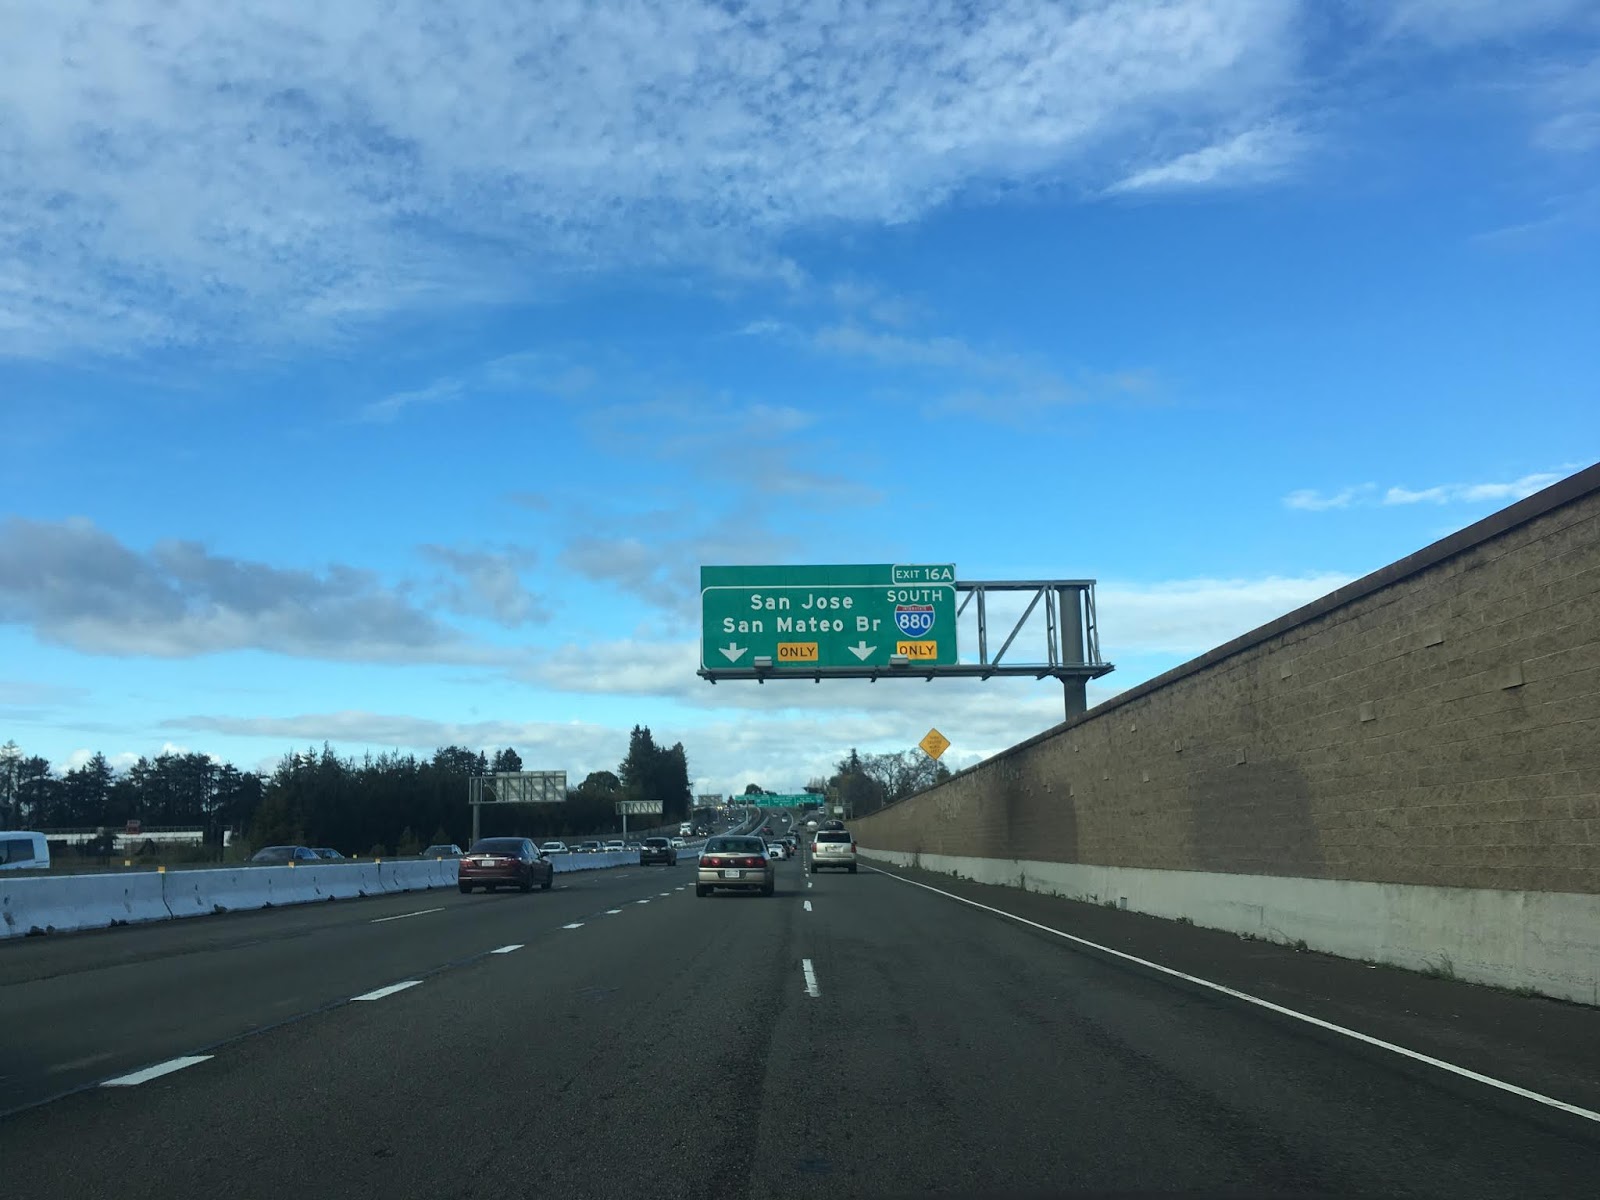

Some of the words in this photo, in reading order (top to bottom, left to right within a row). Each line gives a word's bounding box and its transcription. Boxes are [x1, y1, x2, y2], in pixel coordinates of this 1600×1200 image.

[896, 570, 920, 579] EXIT
[925, 568, 953, 580] 16A
[751, 594, 790, 610] San
[802, 594, 854, 610] Jose
[887, 590, 943, 602] SOUTH
[723, 617, 764, 633] San
[777, 617, 844, 633] Mateo
[857, 616, 882, 632] Br
[899, 613, 931, 629] 880
[780, 646, 815, 657] ONLY
[899, 645, 935, 656] ONLY
